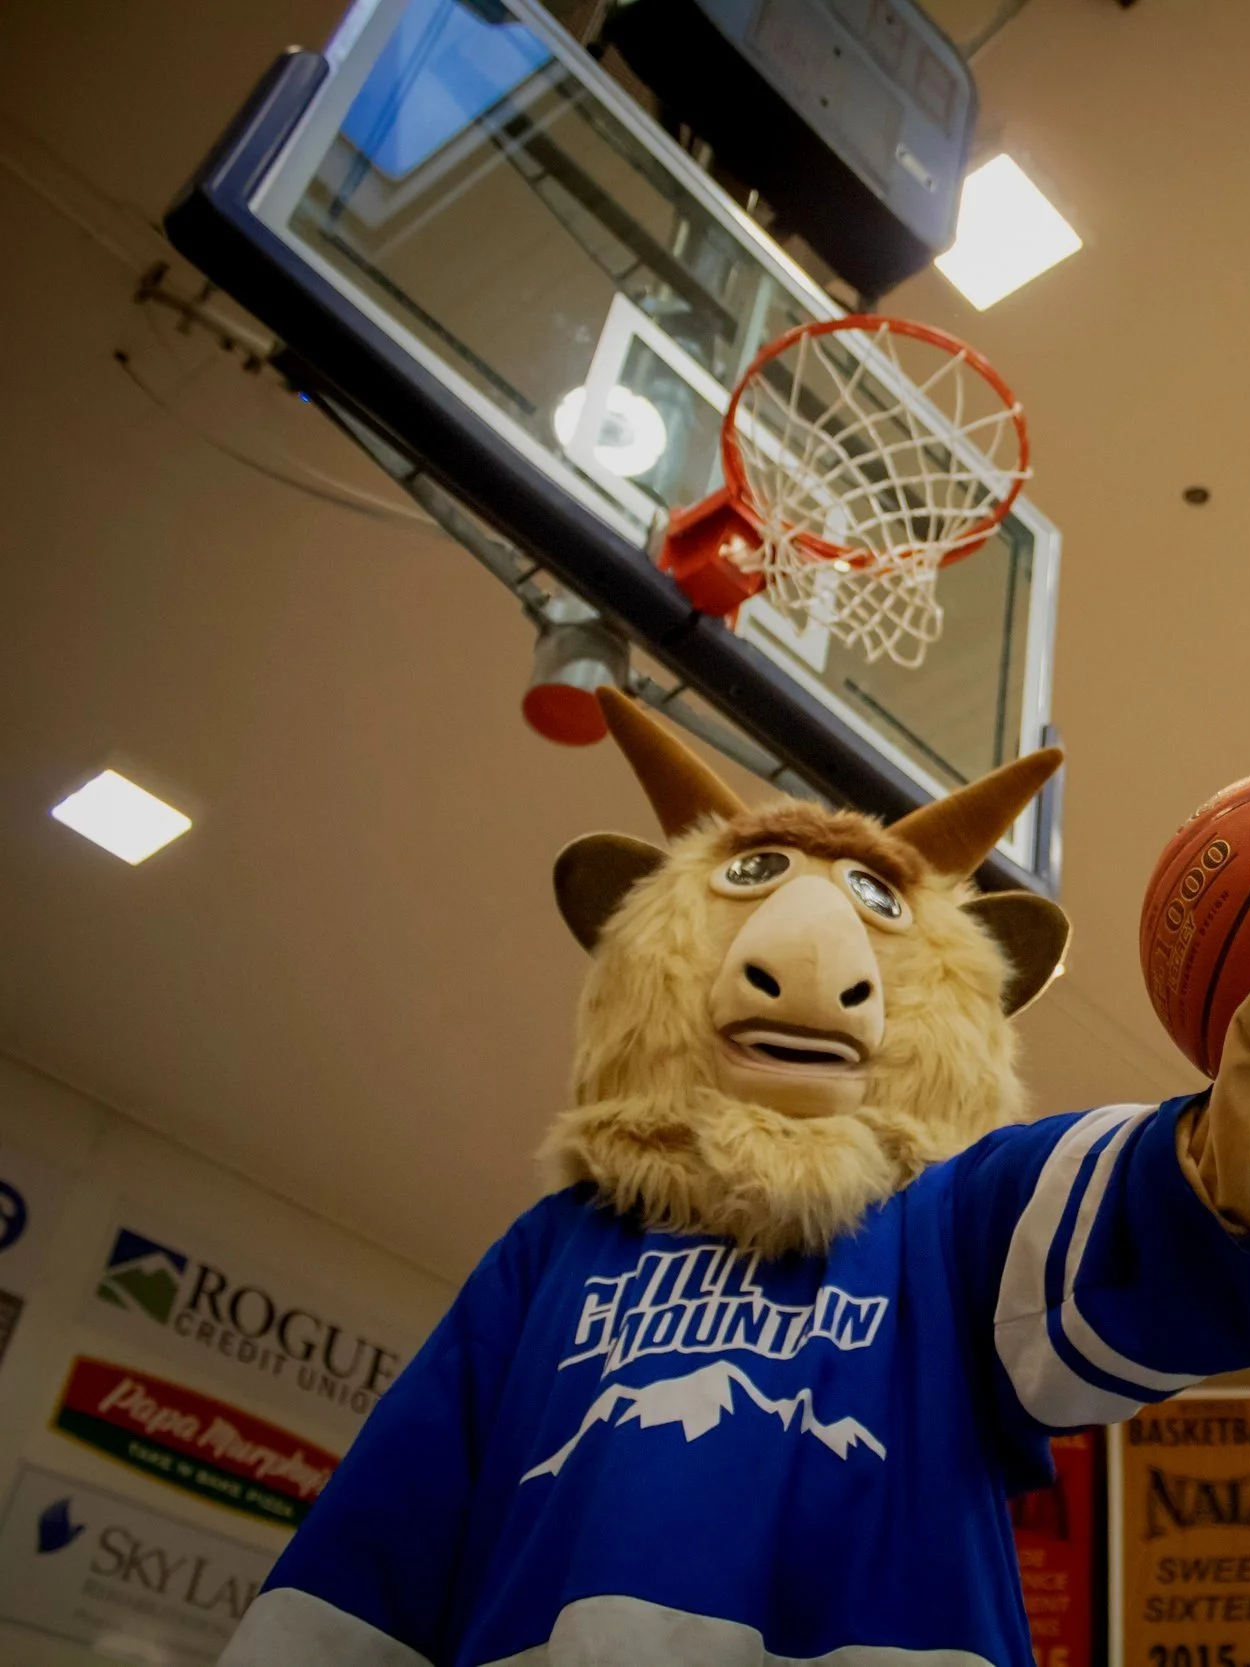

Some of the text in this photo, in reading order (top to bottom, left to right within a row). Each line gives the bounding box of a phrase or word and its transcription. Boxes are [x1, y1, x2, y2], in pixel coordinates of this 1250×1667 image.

[173, 1310, 371, 1415] CREDIT UNIO
[185, 1262, 401, 1398] ROGUE
[96, 1376, 203, 1442] Papa
